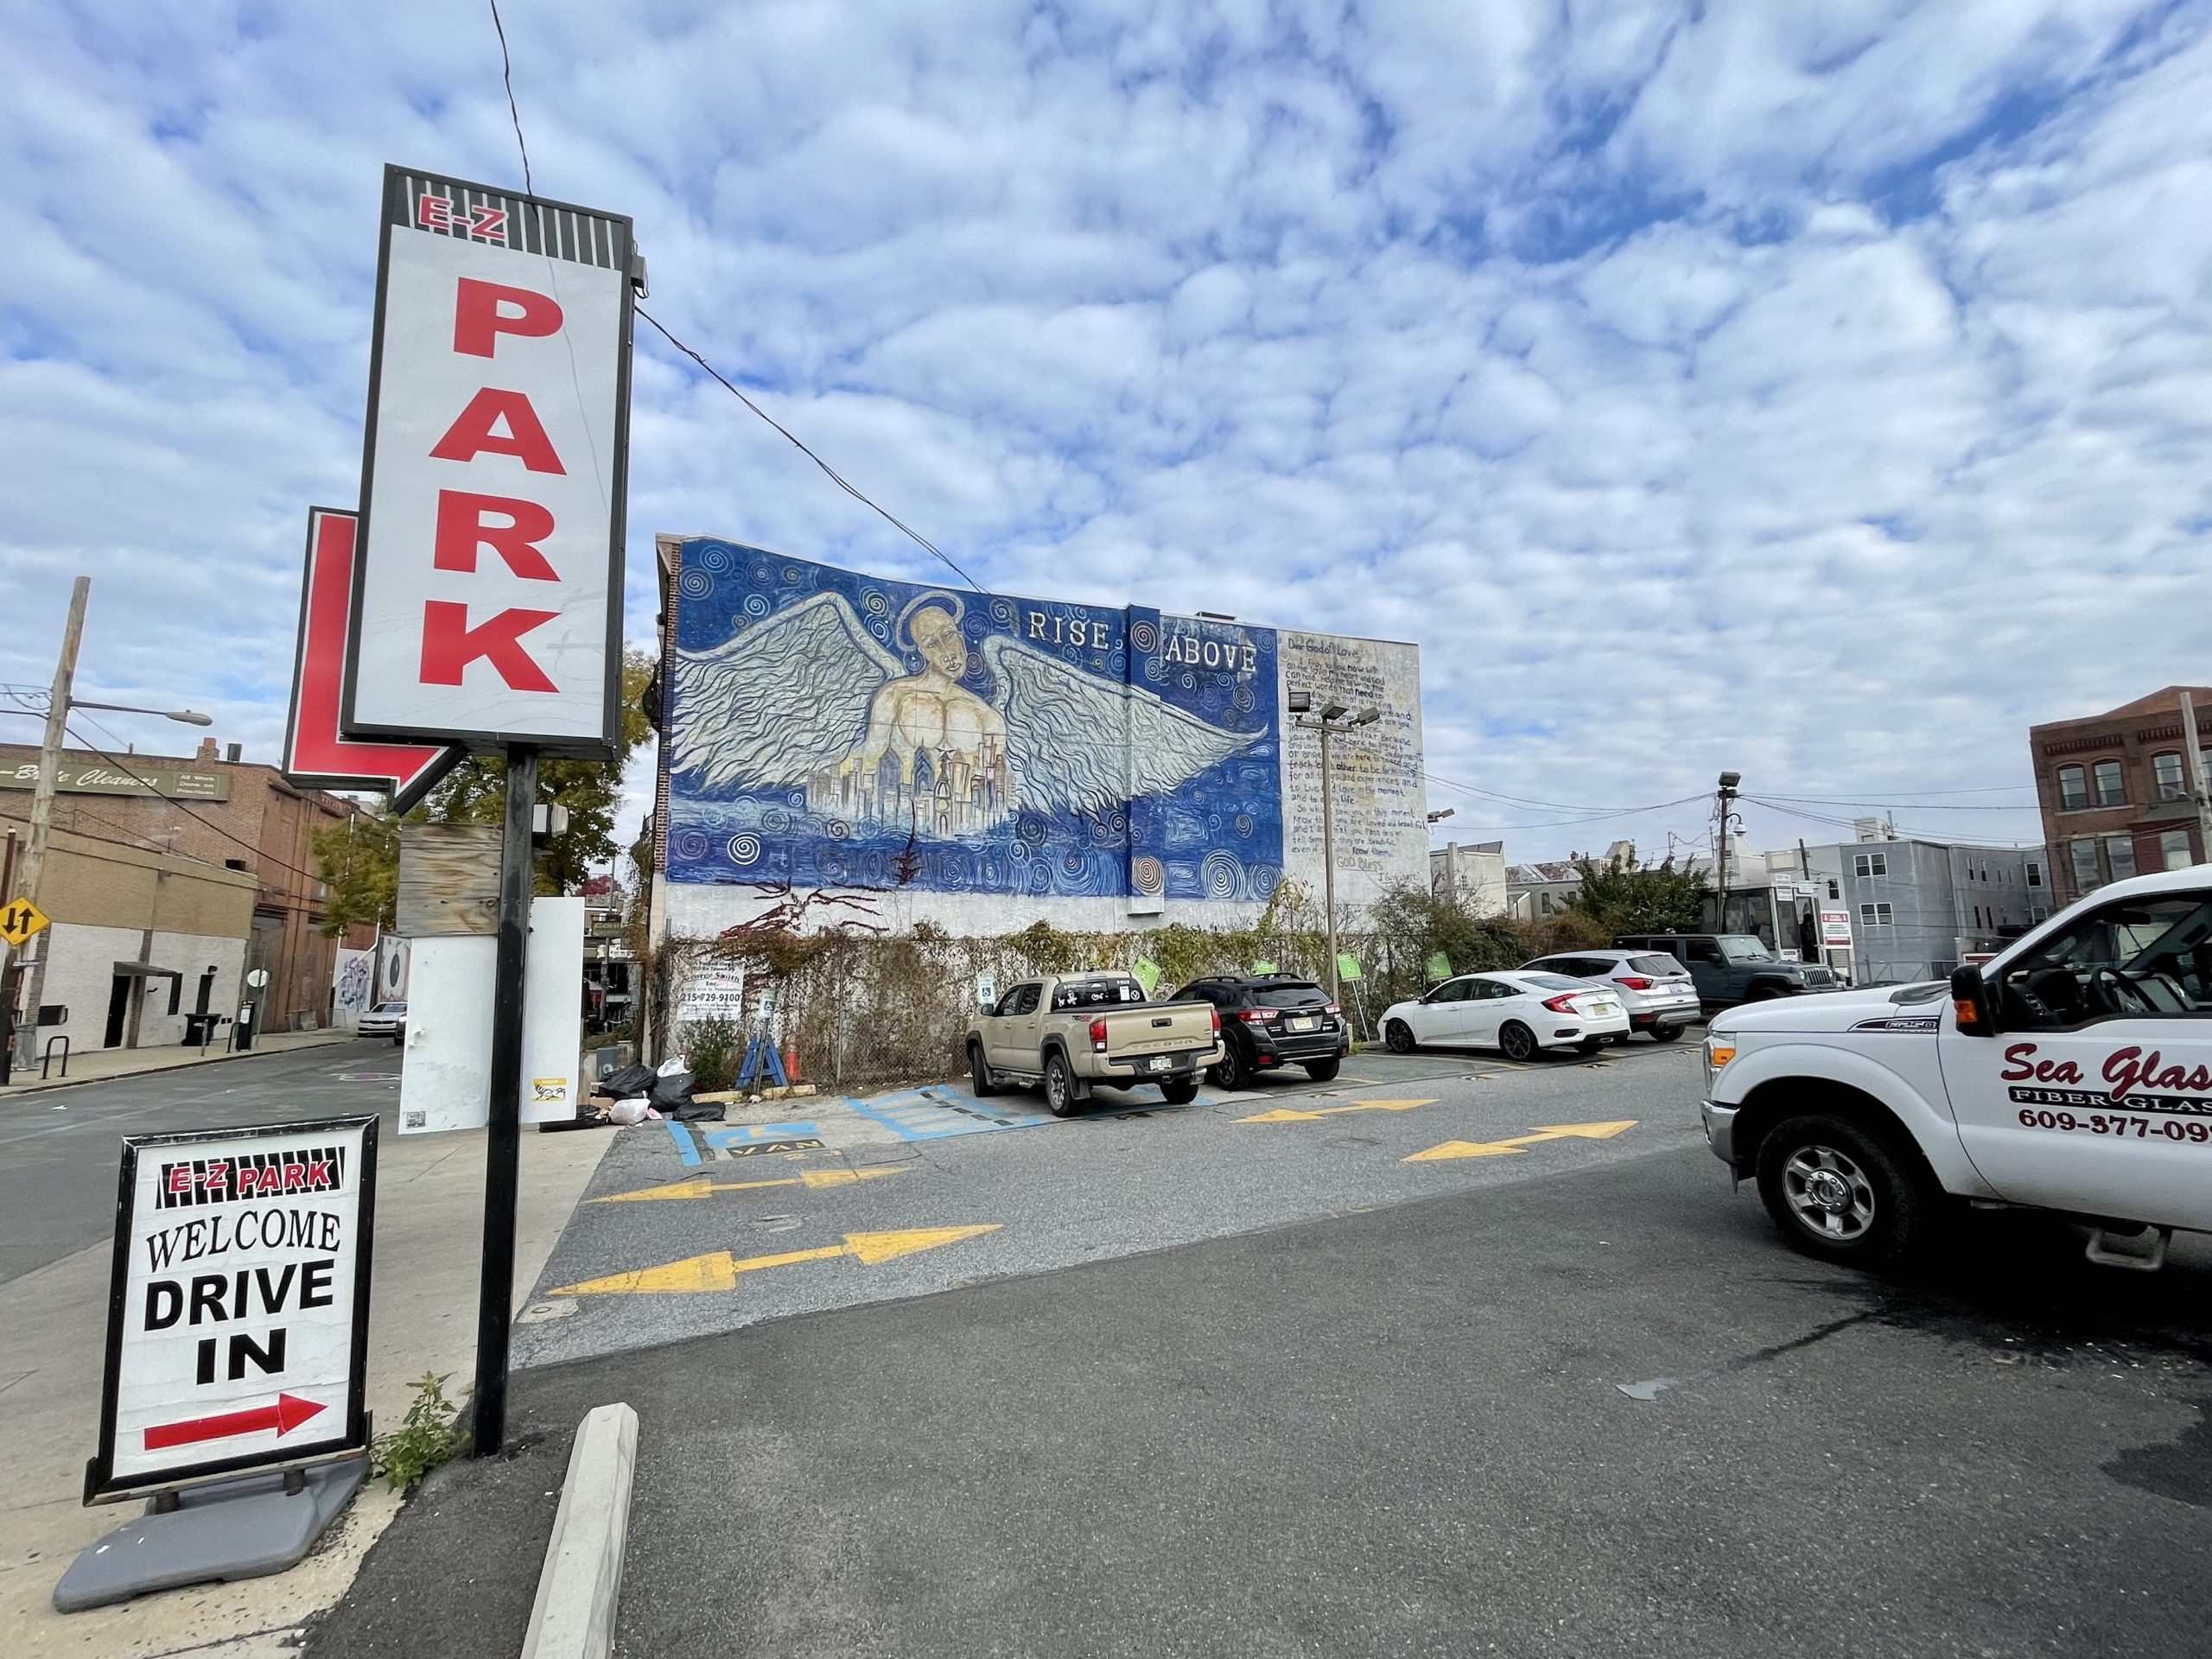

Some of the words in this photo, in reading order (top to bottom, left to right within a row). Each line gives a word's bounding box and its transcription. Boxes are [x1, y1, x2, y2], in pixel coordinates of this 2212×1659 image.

[417, 193, 507, 241] E-Z
[419, 276, 568, 694] PARK
[1028, 611, 1109, 651] RISE
[1165, 635, 1256, 673] ABOVE
[1306, 639, 1324, 654] God
[1341, 671, 1357, 680] heart
[1287, 679, 1312, 690] perfect
[1315, 683, 1337, 692] words
[1339, 685, 1353, 695] that
[1355, 689, 1373, 698] need
[1288, 760, 1313, 770] teach
[1337, 761, 1356, 772] other
[1360, 763, 1369, 772] to
[1370, 764, 1380, 773] be
[1303, 752, 1322, 762] ange
[1403, 761, 1418, 770] and
[76, 769, 157, 787] Cleaners
[1288, 771, 1302, 781] for
[1357, 775, 1399, 786] experiences
[1402, 779, 1417, 788] and
[1378, 787, 1405, 797] moment
[1297, 804, 1306, 812] So
[1351, 810, 1364, 818] you
[1391, 808, 1414, 818] moment
[1335, 817, 1347, 827] you
[1337, 855, 1355, 868] GOD
[715, 972, 741, 982] Smith
[681, 993, 741, 1003] 215-729-9100
[1132, 1039, 1193, 1051] TACOMA
[2000, 1042, 2084, 1084] Sea
[2013, 1090, 2110, 1107] FIBER
[2018, 1109, 2212, 1145] 609-377-09
[730, 1141, 822, 1156] VAN
[168, 1161, 230, 1194] E-Z
[237, 1160, 334, 1196] PARK
[145, 1208, 341, 1274] WELCOME
[143, 1258, 336, 1332] DRIVE
[195, 1327, 288, 1386] IN
